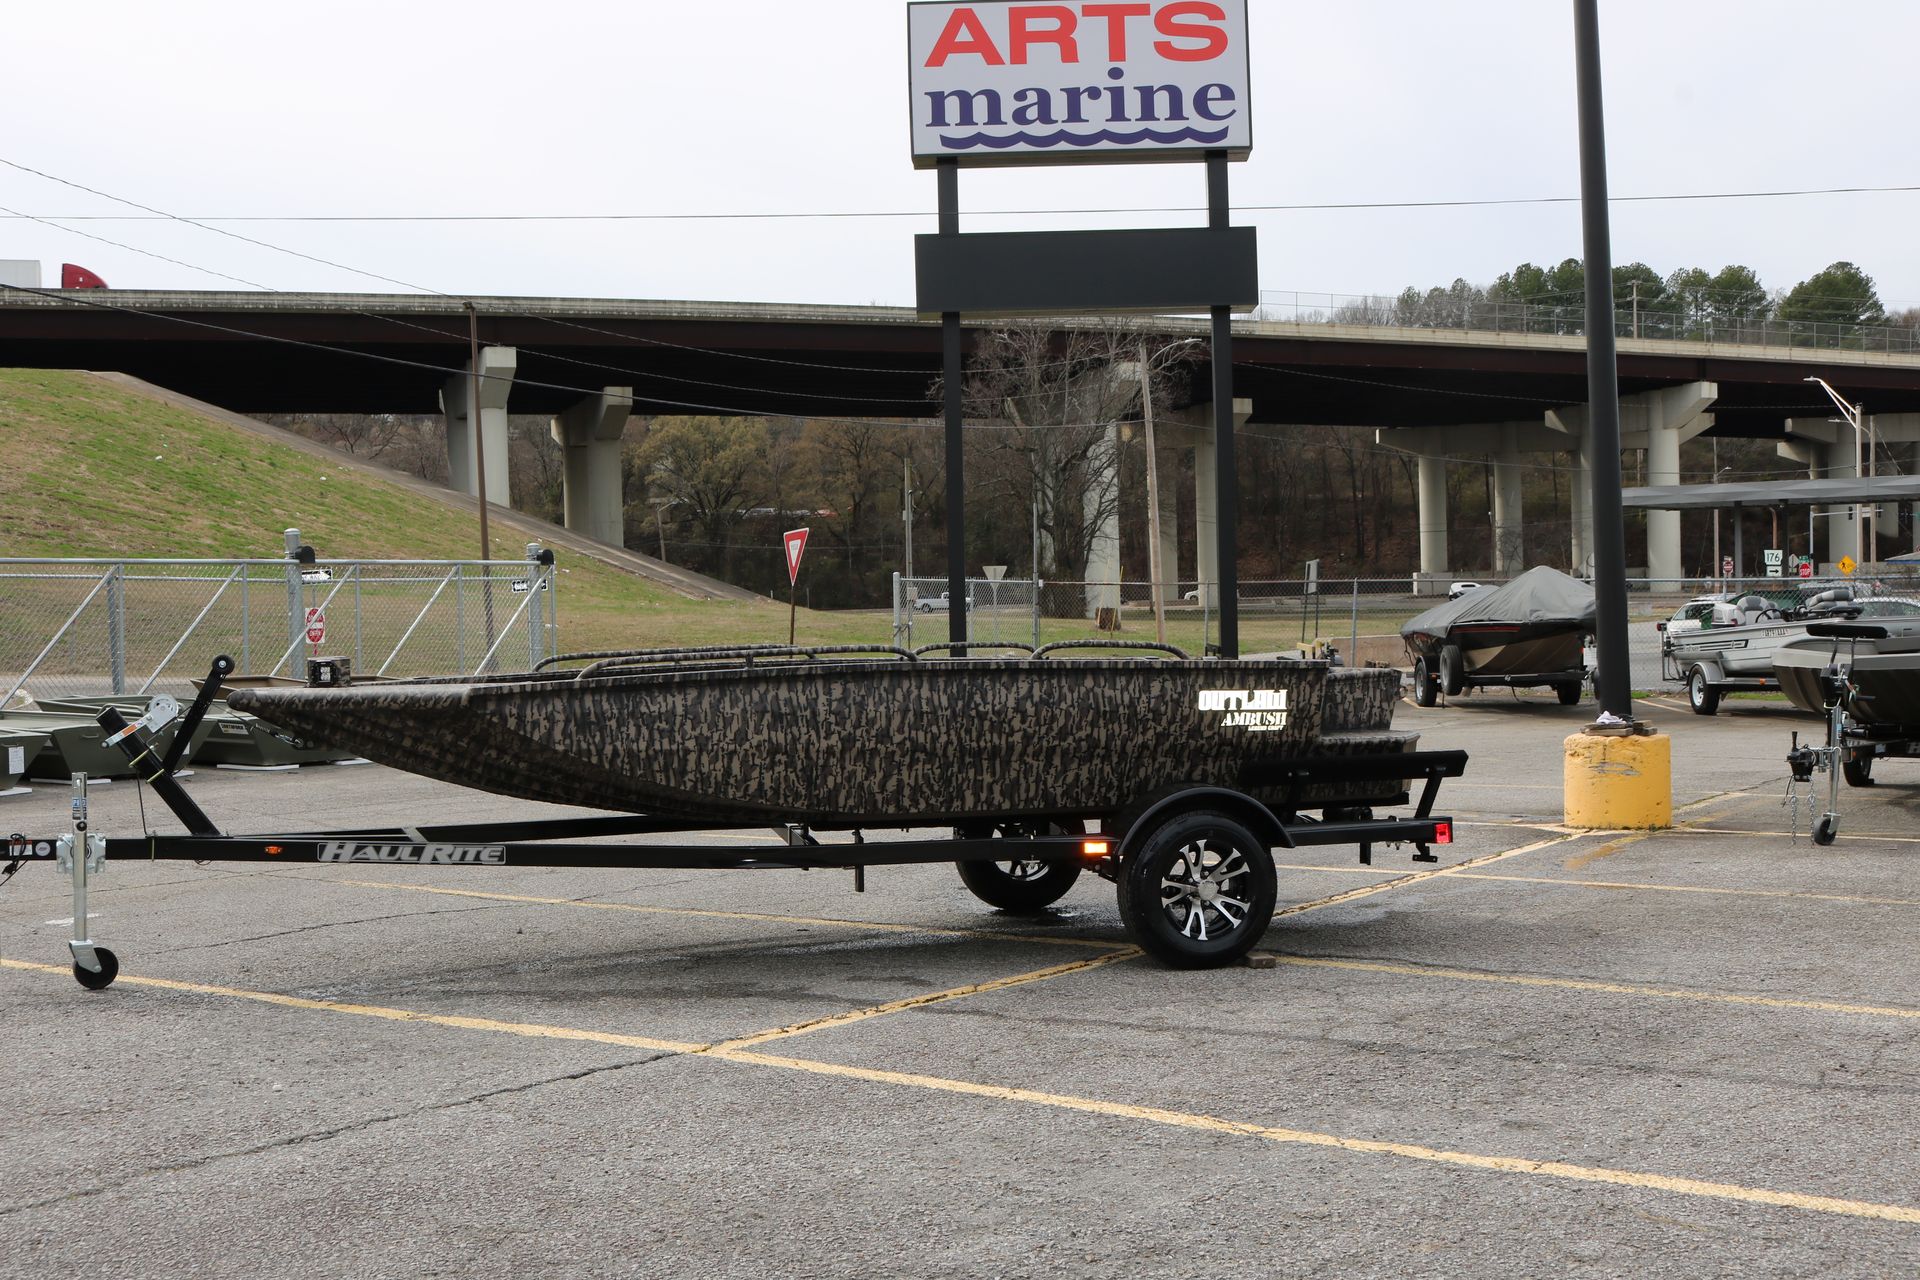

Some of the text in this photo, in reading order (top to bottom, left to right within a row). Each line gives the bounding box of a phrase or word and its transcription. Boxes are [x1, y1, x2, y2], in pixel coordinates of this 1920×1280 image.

[924, 1, 1228, 67] ARTS
[924, 67, 1237, 127] marine
[1766, 553, 1780, 562] 176
[1799, 568, 1811, 576] STOP
[1199, 689, 1288, 711] OUTLAW
[1220, 712, 1288, 726] AMBUSH
